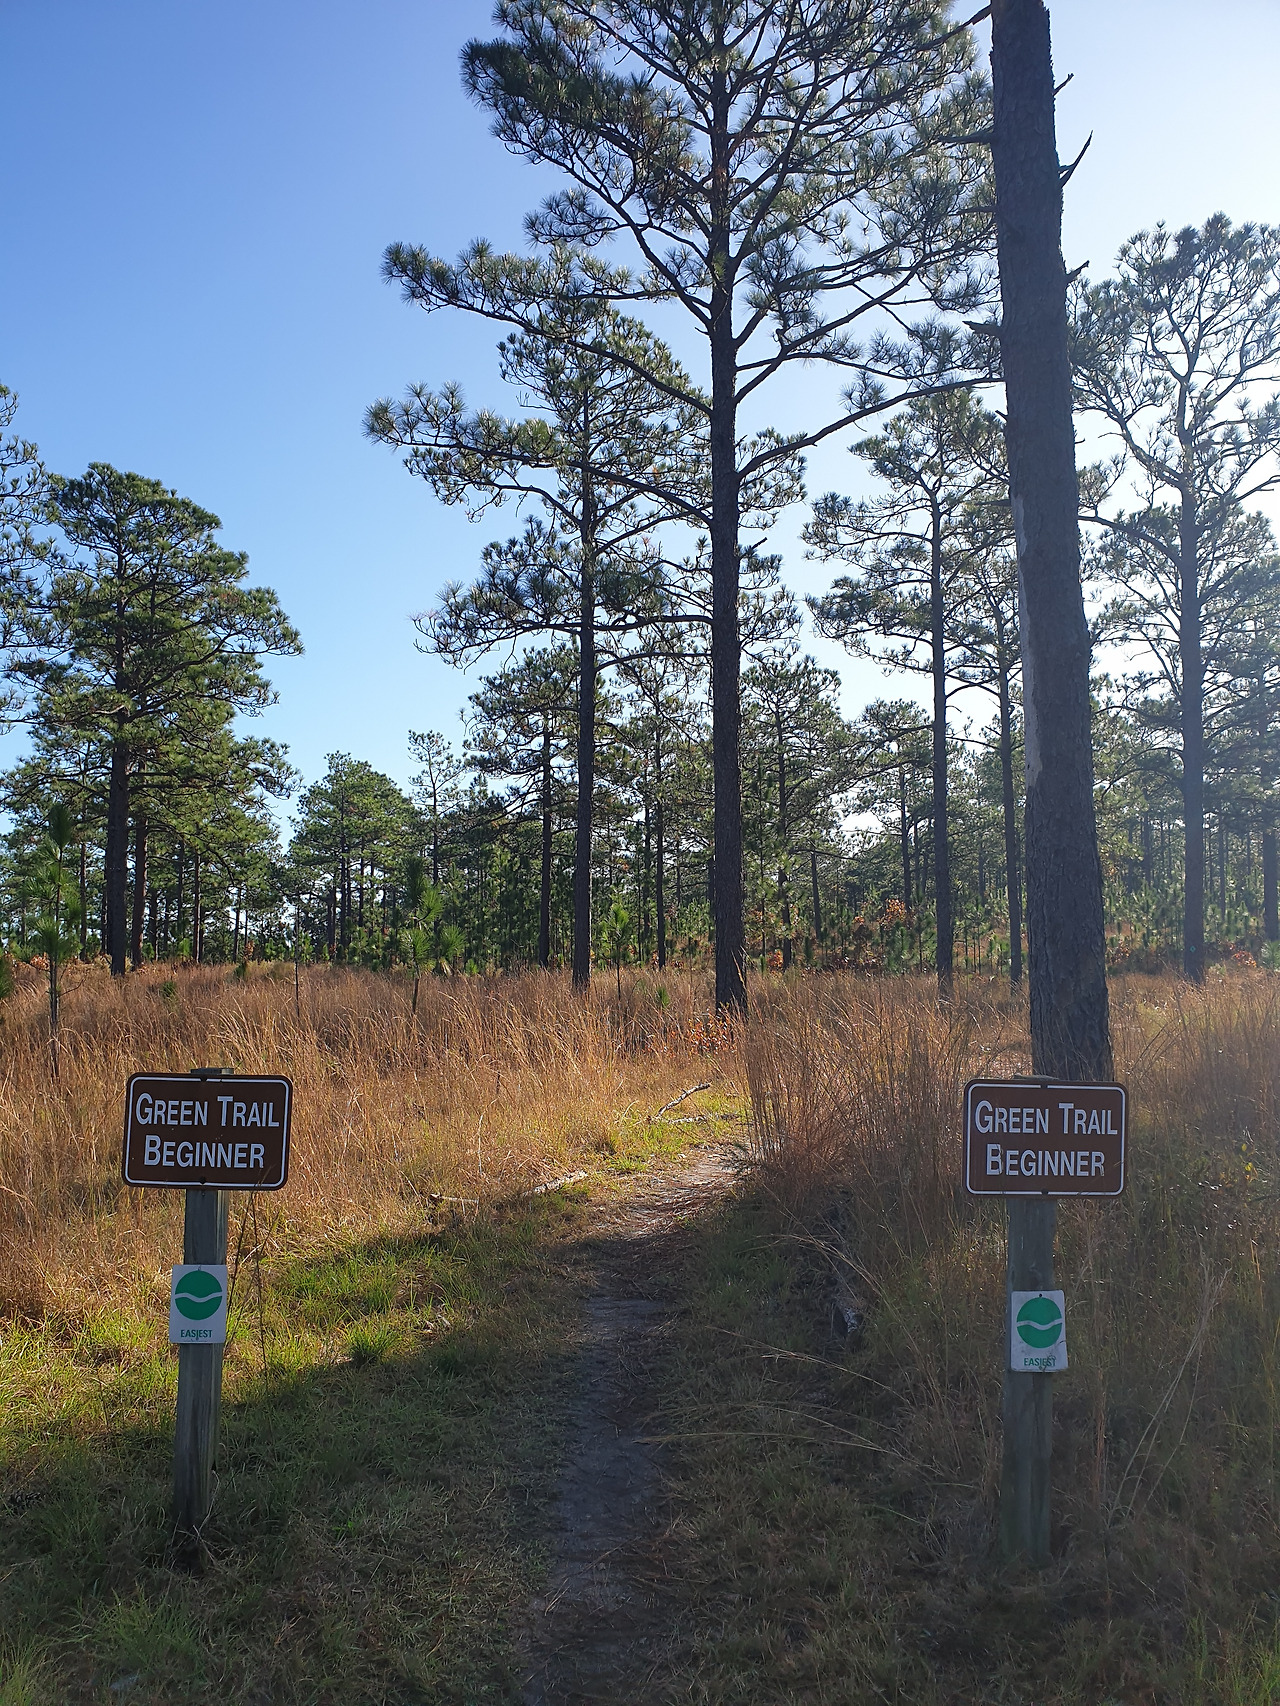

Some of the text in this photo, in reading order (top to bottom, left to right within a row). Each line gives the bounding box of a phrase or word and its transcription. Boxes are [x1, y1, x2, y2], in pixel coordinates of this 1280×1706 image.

[136, 1092, 280, 1127] GREEN TRAIL
[975, 1100, 1118, 1135] GREEN TRAIL
[144, 1134, 265, 1168] BEGINNER
[986, 1143, 1105, 1177] BEGINNER
[180, 1329, 213, 1338] EASIEST
[1023, 1357, 1056, 1367] EASIEST
